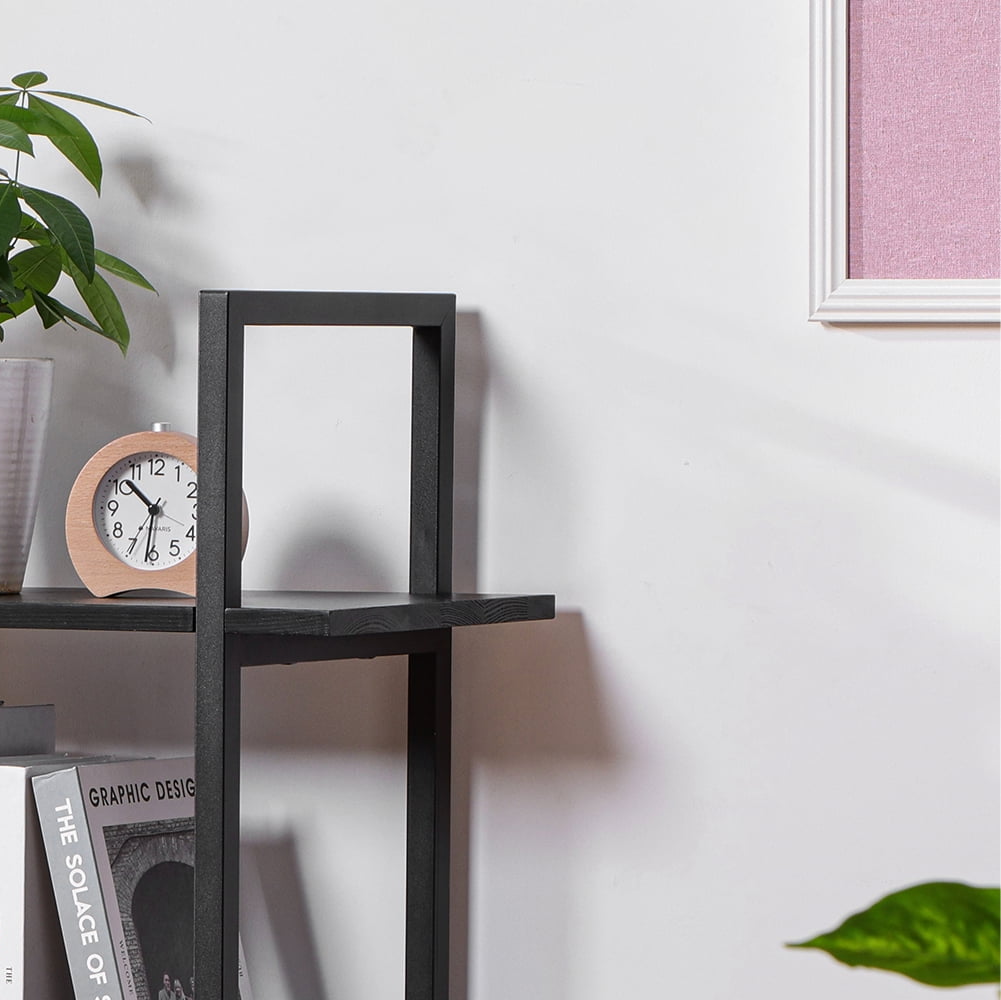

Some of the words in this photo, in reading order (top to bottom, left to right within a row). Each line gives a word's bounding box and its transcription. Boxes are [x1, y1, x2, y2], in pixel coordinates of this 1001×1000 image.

[129, 463, 142, 480] 11
[148, 459, 165, 476] 12
[174, 465, 180, 482] 1
[112, 478, 134, 495] 10
[186, 482, 198, 499] 2
[107, 500, 119, 516] 9
[112, 522, 123, 538] 8
[185, 525, 196, 541] 4
[128, 538, 138, 554] 7
[147, 545, 159, 561] 6
[169, 539, 180, 556] 5
[89, 782, 151, 807] GRAPHIC
[155, 778, 196, 801] DESIG
[55, 797, 79, 846] THE
[66, 854, 99, 946] SOLACE
[86, 953, 107, 985] OF
[119, 940, 134, 993] WELCOME
